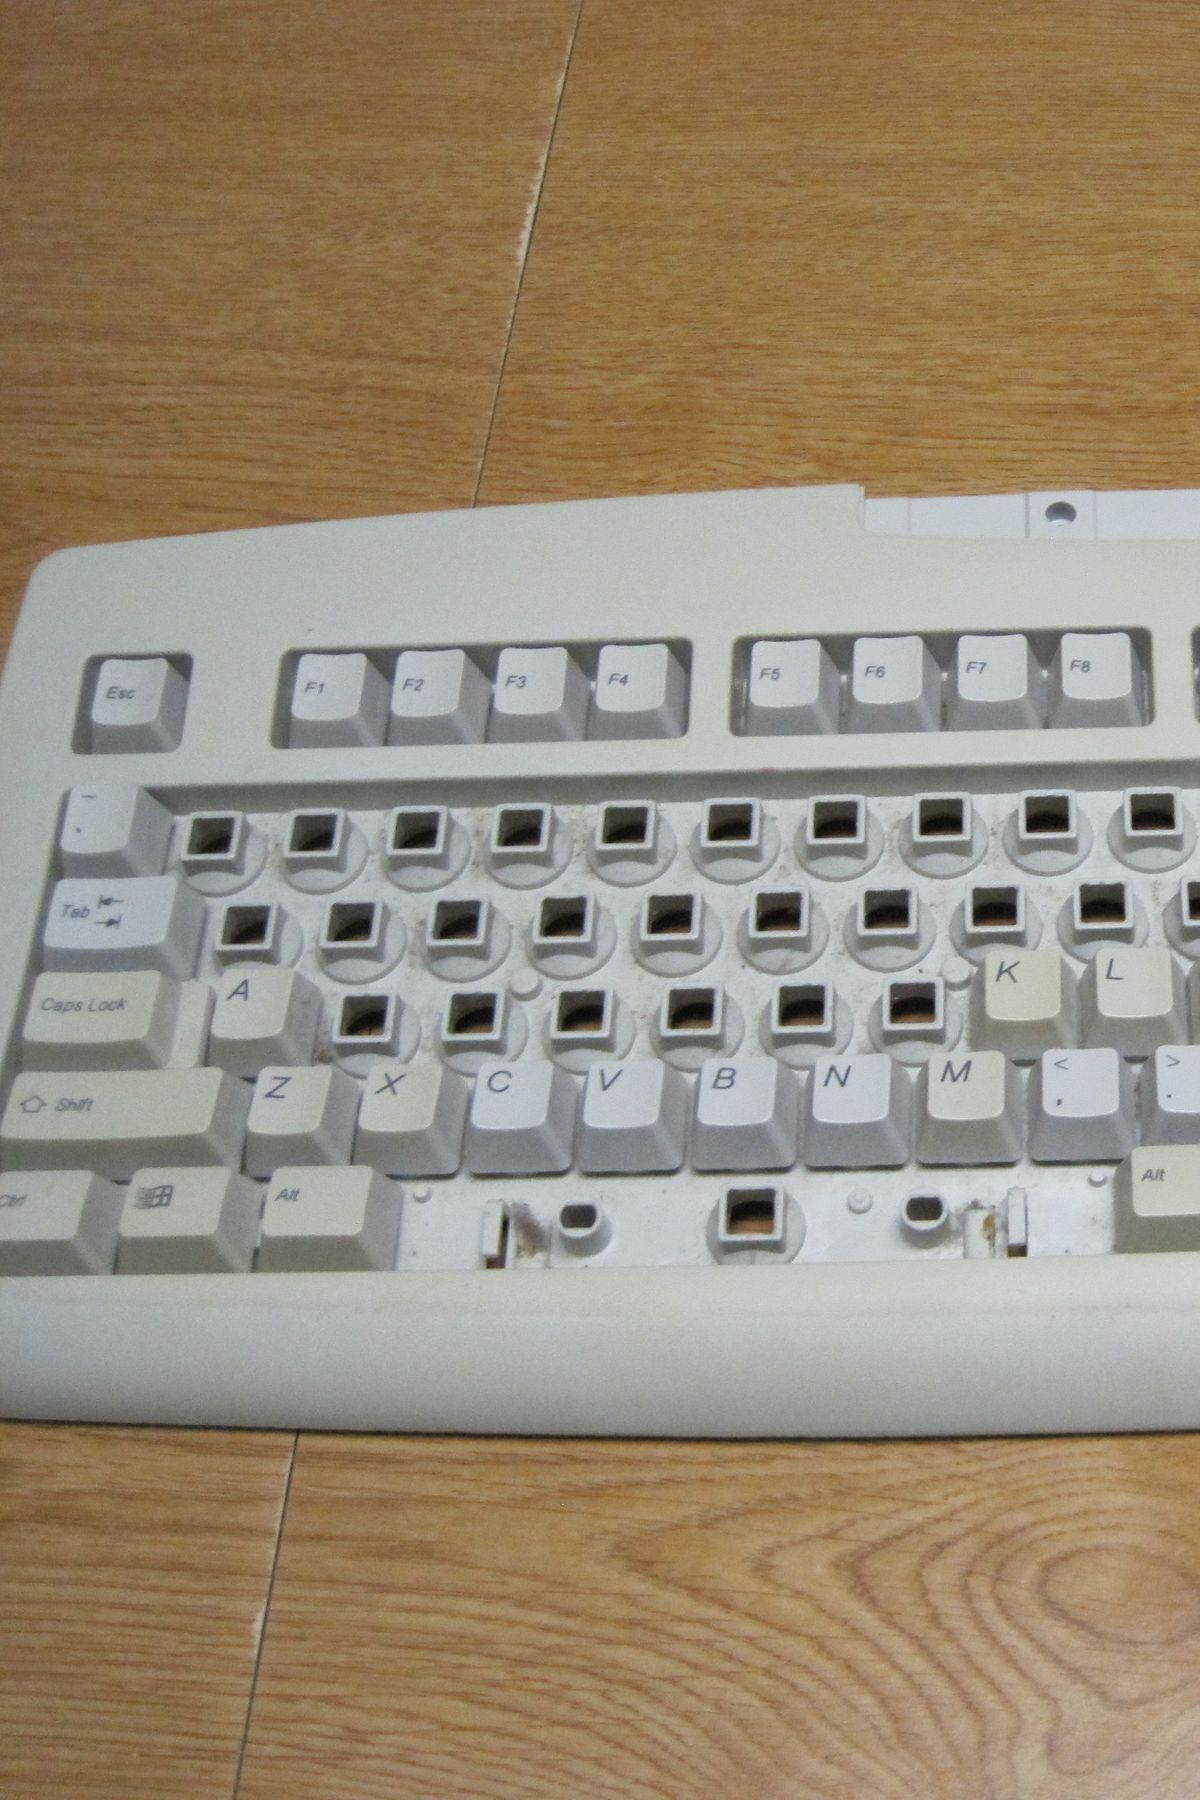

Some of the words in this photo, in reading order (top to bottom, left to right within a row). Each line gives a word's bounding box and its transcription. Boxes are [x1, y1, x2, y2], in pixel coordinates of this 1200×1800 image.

[864, 665, 886, 679] F6
[966, 661, 987, 675] F7
[1070, 659, 1091, 673] F8
[608, 673, 629, 687] F4
[759, 667, 781, 681] F5
[304, 681, 325, 695] F1
[403, 678, 424, 692] F2
[505, 675, 527, 689] F3
[105, 686, 136, 700] Esc
[61, 905, 90, 918] Tab
[995, 960, 1021, 984] K
[1106, 958, 1124, 981] L
[227, 979, 249, 1001] A
[41, 998, 82, 1013] Caps
[87, 998, 127, 1012] Lock
[712, 1067, 736, 1090] B
[824, 1065, 852, 1087] N
[940, 1060, 973, 1083] M
[264, 1076, 292, 1099] Z
[374, 1072, 407, 1096] X
[487, 1070, 512, 1093] C
[599, 1069, 623, 1092] V
[55, 1098, 94, 1112] Shift
[1141, 1168, 1166, 1183] Alt
[275, 1188, 300, 1202] Alt
